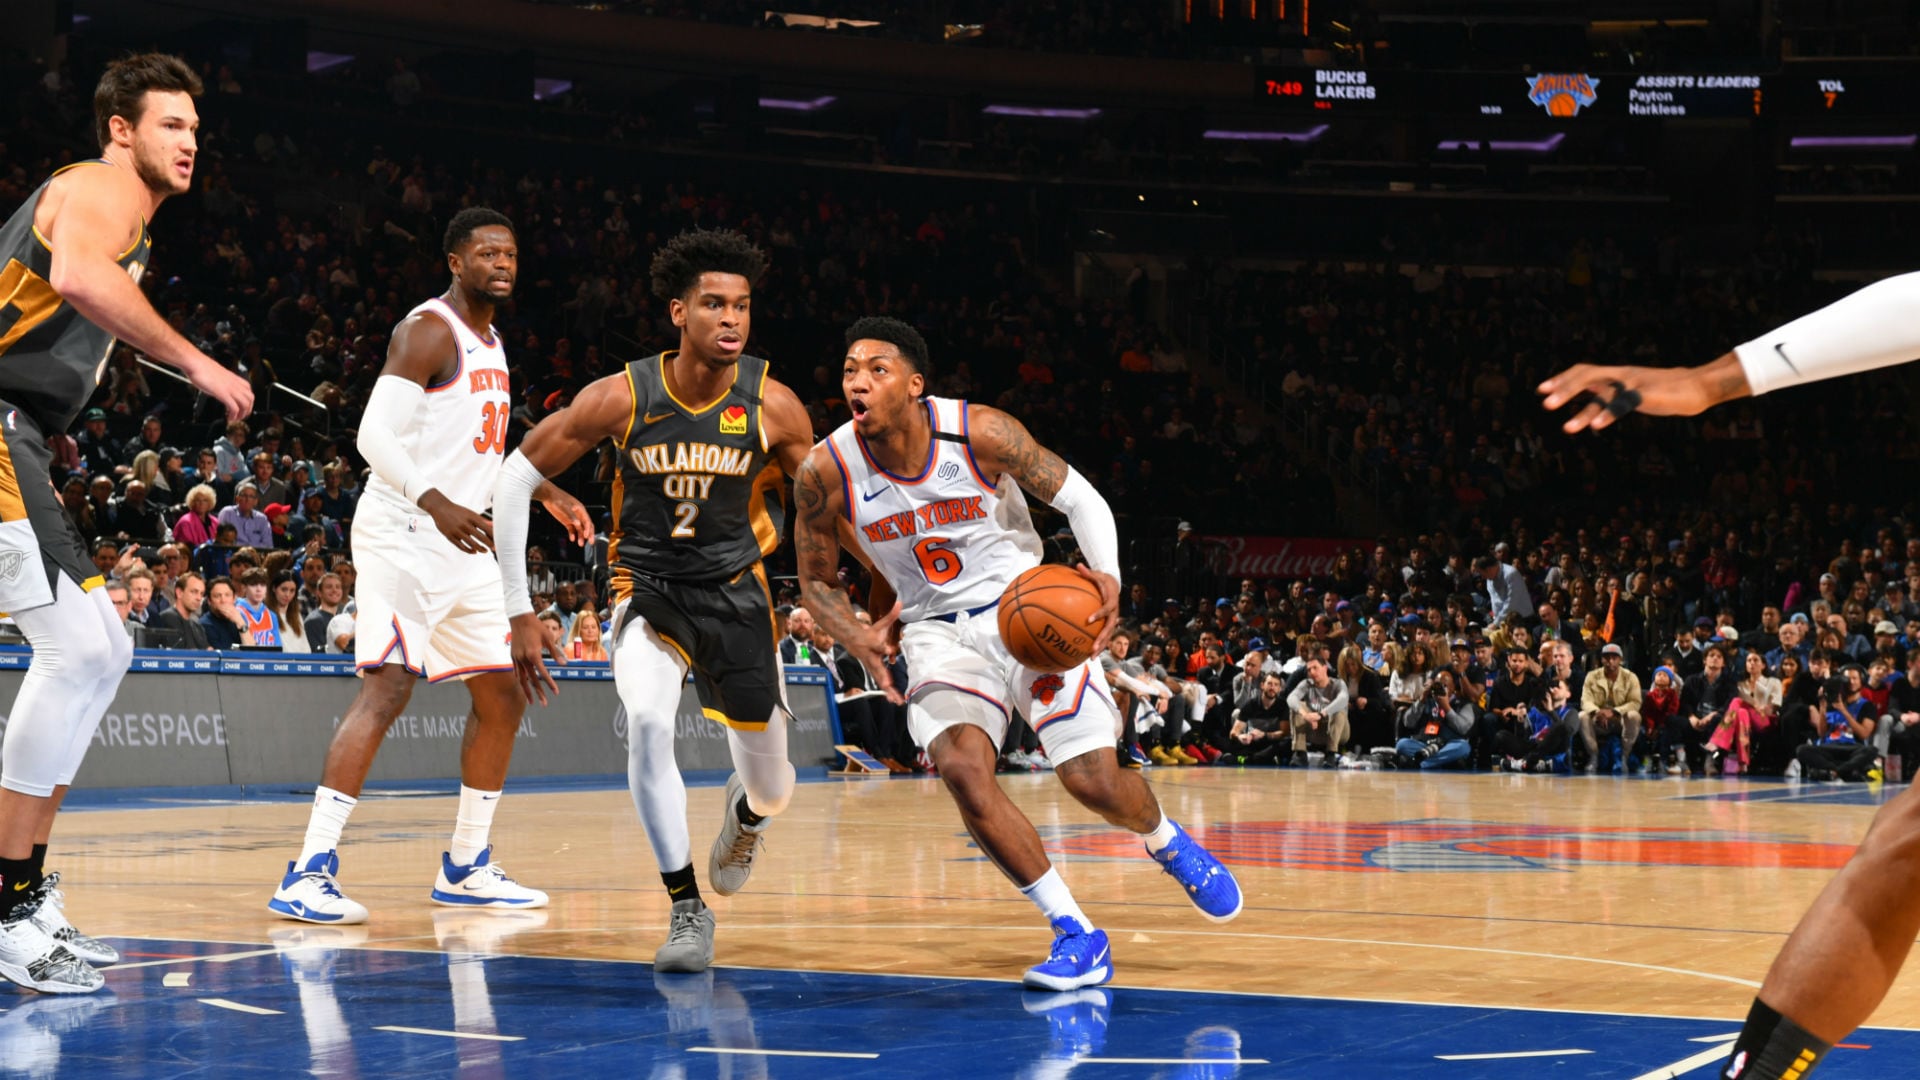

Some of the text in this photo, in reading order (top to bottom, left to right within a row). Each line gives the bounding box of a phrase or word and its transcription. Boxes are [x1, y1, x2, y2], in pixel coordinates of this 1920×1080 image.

[1265, 80, 1303, 96] 7:49
[1315, 70, 1367, 84] BUCKS
[1636, 76, 1761, 88] ASSISTS LEADERS
[1818, 80, 1845, 92] TOL
[1315, 85, 1376, 99] LAKERS
[1629, 89, 1673, 103] Payton
[1824, 92, 1838, 109] 7
[1629, 103, 1686, 115] Harkless
[468, 368, 494, 394] NEW
[473, 401, 509, 454] 30
[630, 442, 753, 476] OKLAHOMA
[664, 474, 715, 500] CITY
[671, 501, 699, 538] 2
[862, 495, 988, 543] NEW YORK
[912, 536, 963, 586] 6
[1203, 536, 1342, 576] Budwei
[91, 713, 229, 746] ARESPACE
